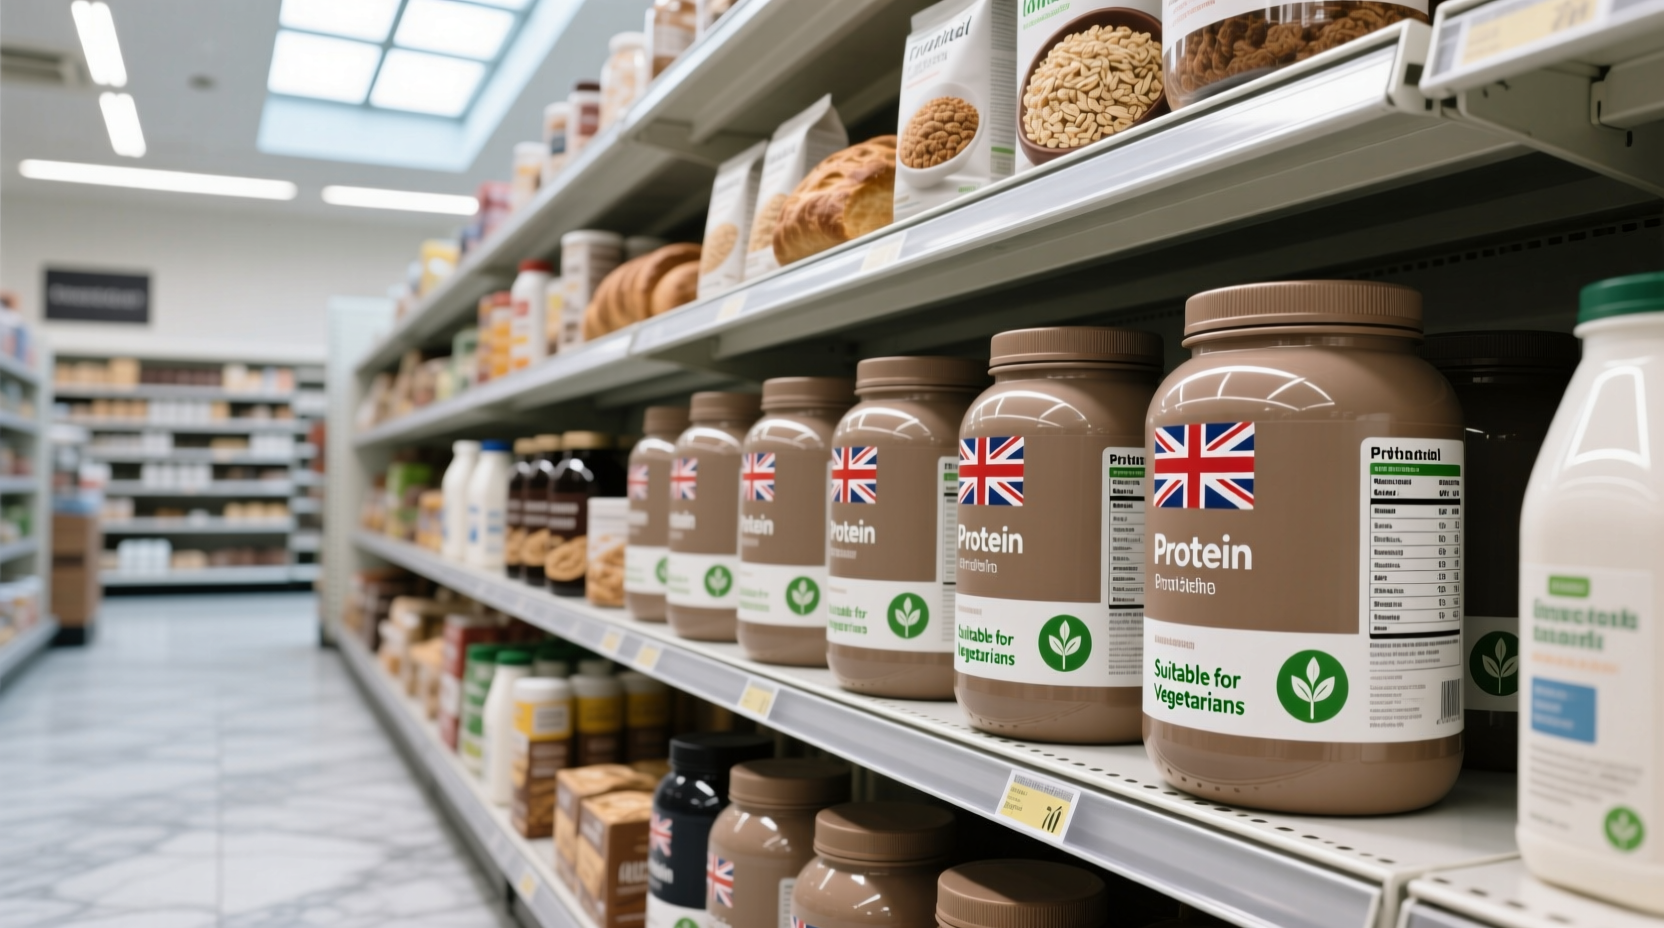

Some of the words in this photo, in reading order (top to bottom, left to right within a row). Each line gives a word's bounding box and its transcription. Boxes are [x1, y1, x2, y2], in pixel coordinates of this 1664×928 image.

[957, 524, 1023, 554] Protein
[1154, 533, 1253, 570] Protein
[995, 629, 1014, 646] for
[1154, 658, 1210, 686] Suitable
[1213, 667, 1241, 689] for
[1153, 682, 1245, 715] Vegetarians
